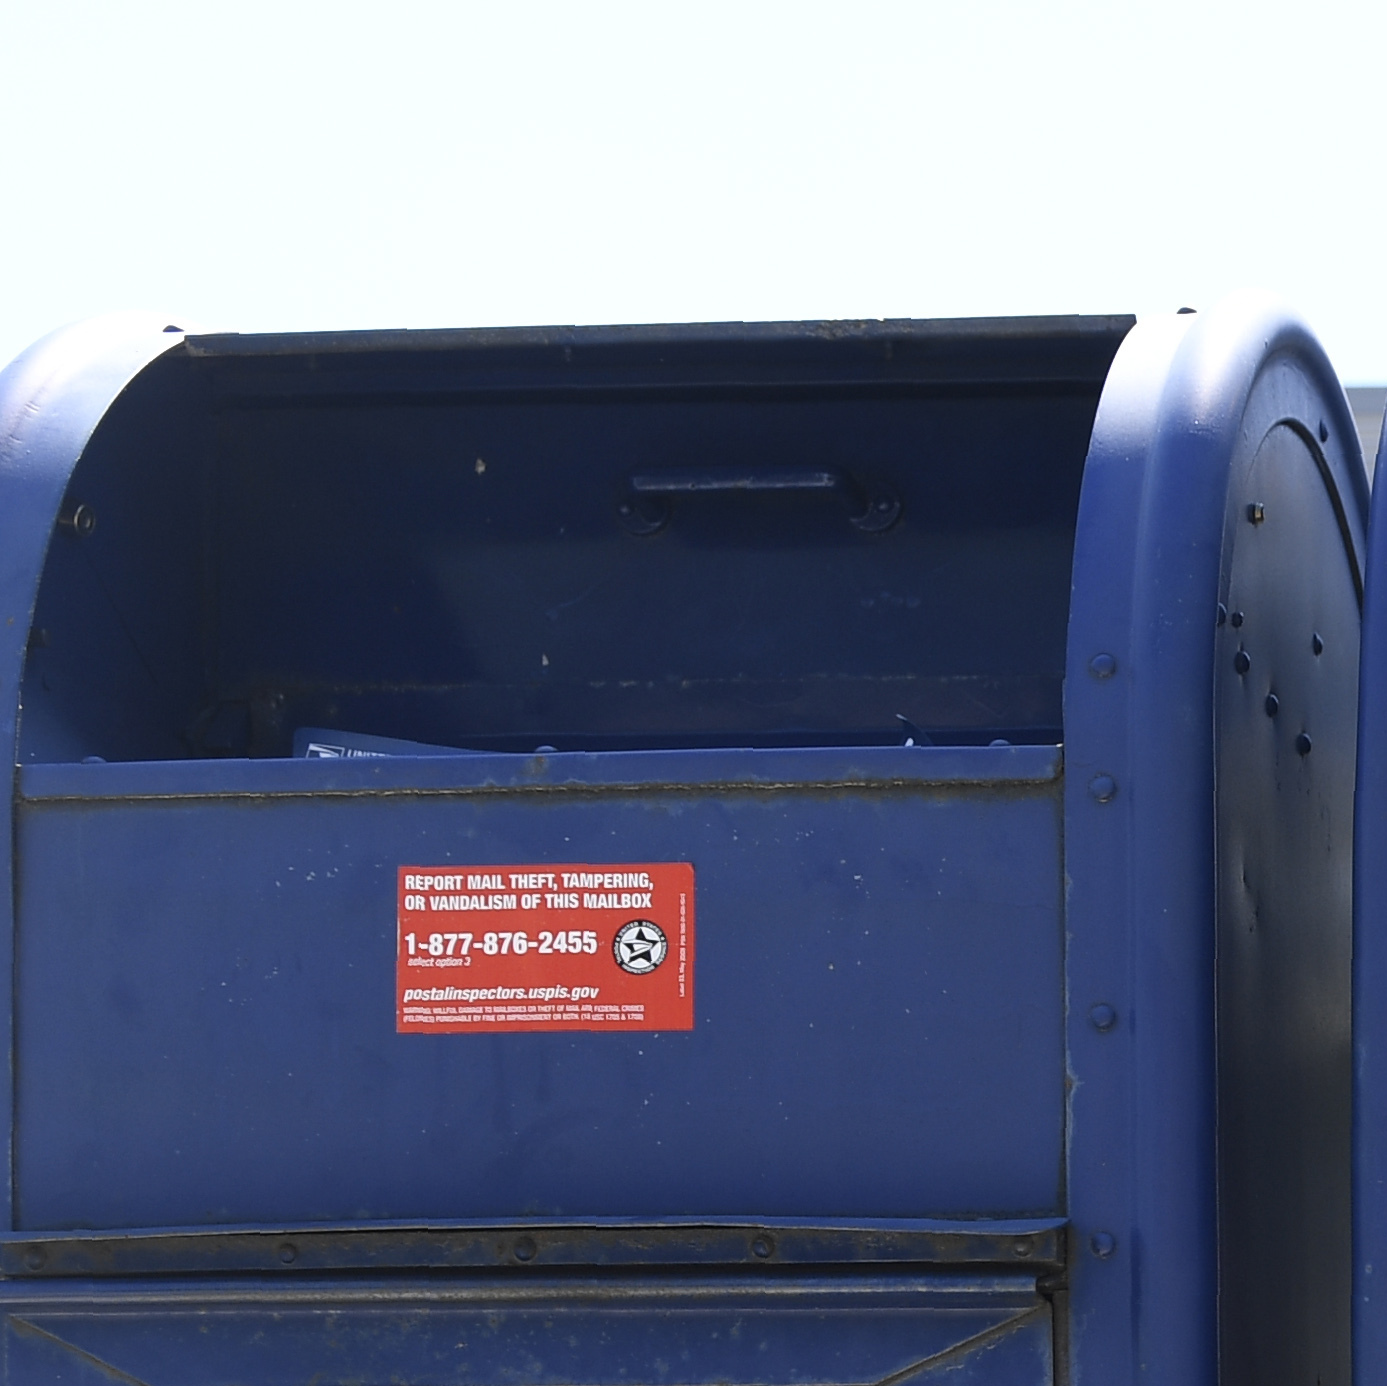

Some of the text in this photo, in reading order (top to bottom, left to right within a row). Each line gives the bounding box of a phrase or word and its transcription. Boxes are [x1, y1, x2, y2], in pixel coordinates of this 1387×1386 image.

[406, 873, 653, 891] REPORT MAIL THEFT, TAMPERING,
[405, 893, 651, 910] OR VANDALISM OF THIS MAILBOX
[405, 931, 597, 955] 1-877-876-2455
[407, 957, 434, 967] select
[436, 958, 462, 967] option
[404, 985, 599, 1002] postalinspectors.uspis.gov
